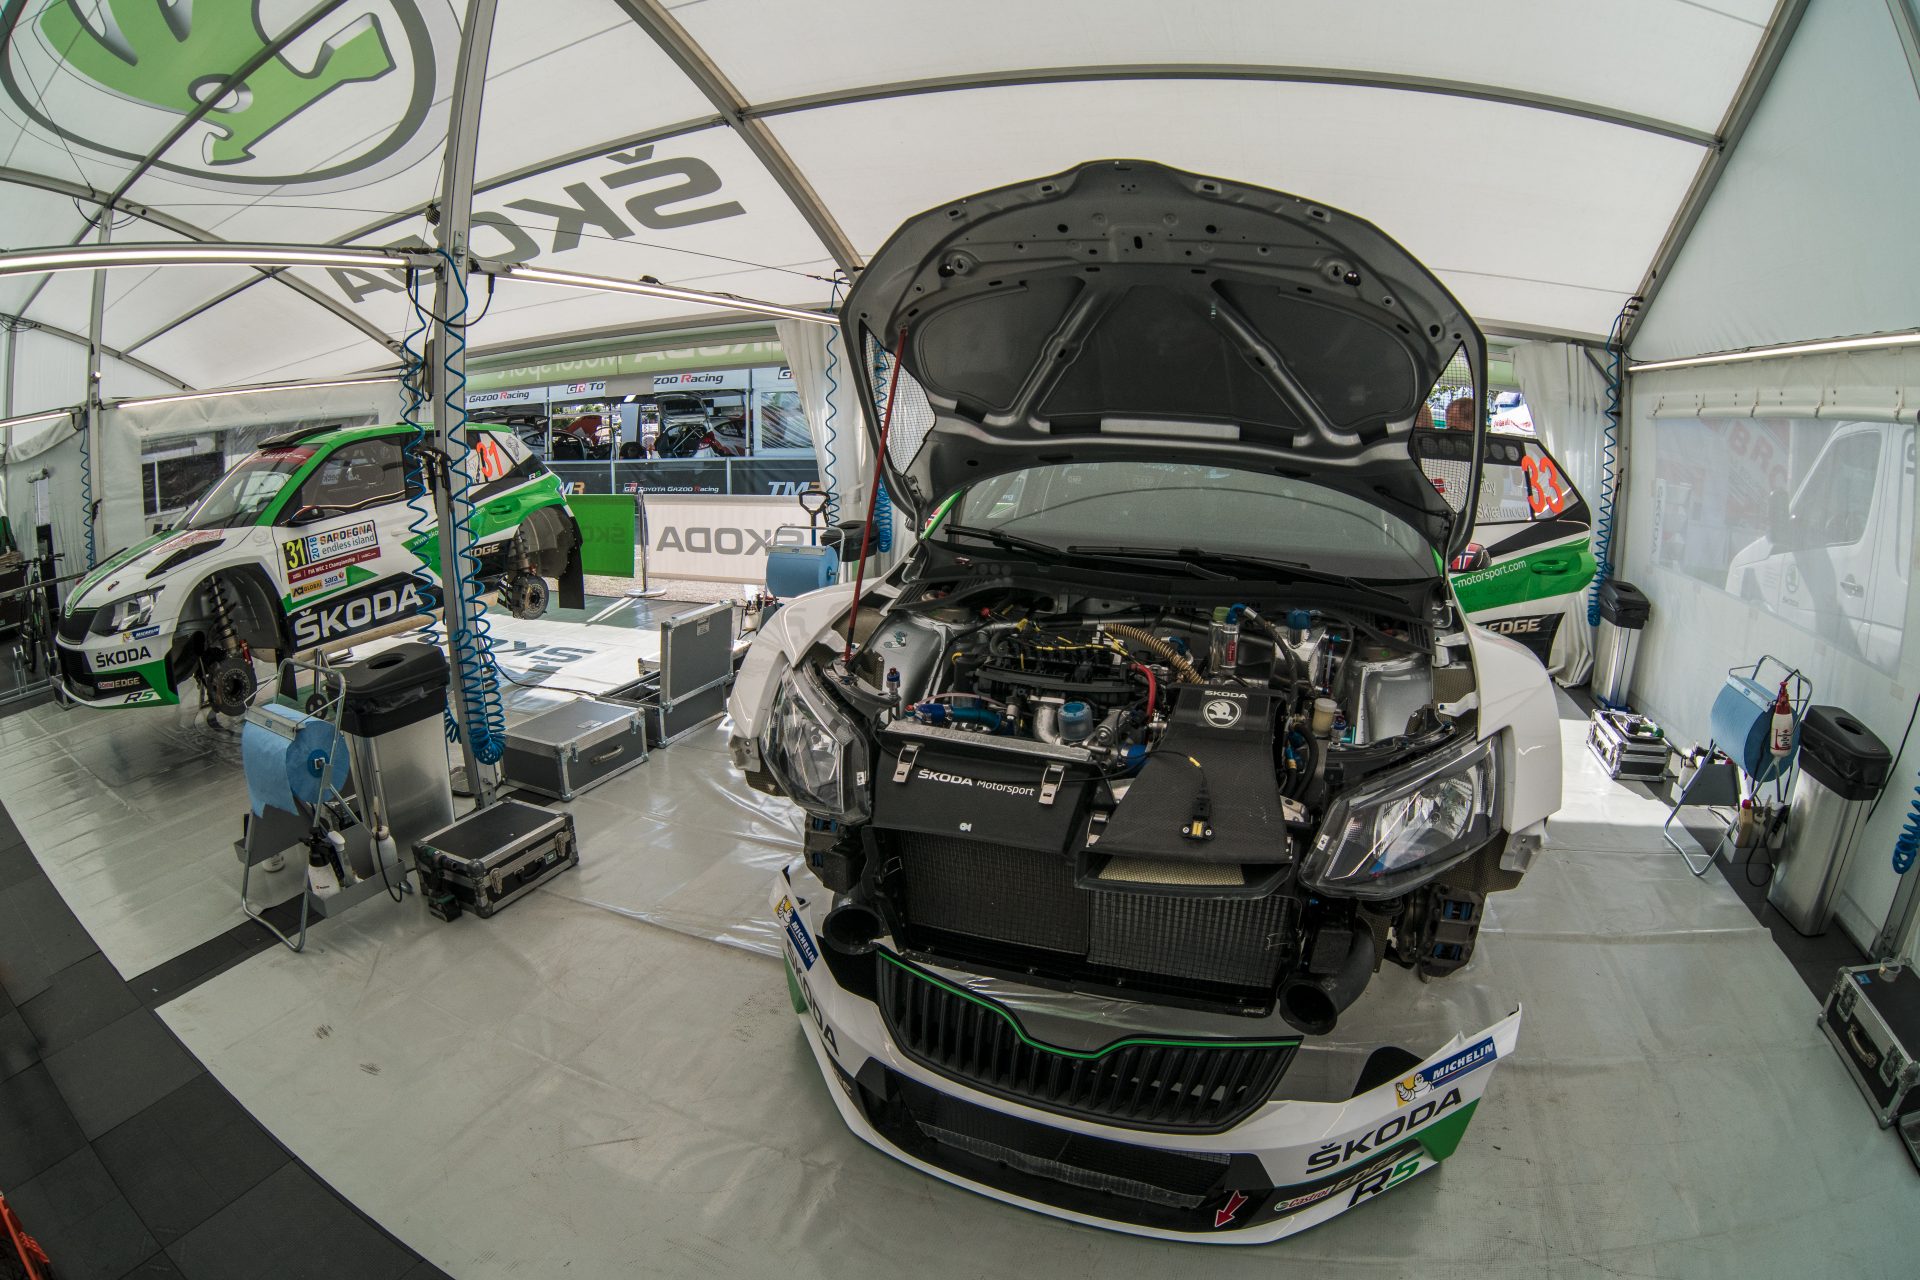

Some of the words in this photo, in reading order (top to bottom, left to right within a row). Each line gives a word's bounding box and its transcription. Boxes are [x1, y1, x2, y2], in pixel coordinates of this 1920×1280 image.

[567, 383, 586, 394] GR
[681, 374, 724, 384] Racing
[469, 394, 498, 403] GAZOO
[500, 391, 530, 400] Racing
[476, 440, 503, 478] 31
[1521, 455, 1564, 513] 33
[320, 524, 373, 545] SARDEGNA
[322, 541, 351, 555] endless
[353, 534, 375, 548] island
[287, 538, 306, 569] 31
[309, 537, 320, 559] 2018
[324, 575, 338, 585] sara
[294, 582, 423, 647] ŠKODA
[96, 646, 152, 668] ŠKODA
[115, 677, 140, 688] EDGE
[124, 690, 155, 704] R5
[918, 768, 973, 787] ŠKODA
[977, 780, 1035, 796] Motorsport
[791, 920, 817, 963] MICHELIN
[1432, 1041, 1494, 1081] MICHELIN
[1305, 1087, 1462, 1175] ŠKODA
[1347, 1150, 1424, 1208] R5
[1287, 1186, 1331, 1208] Castrol
